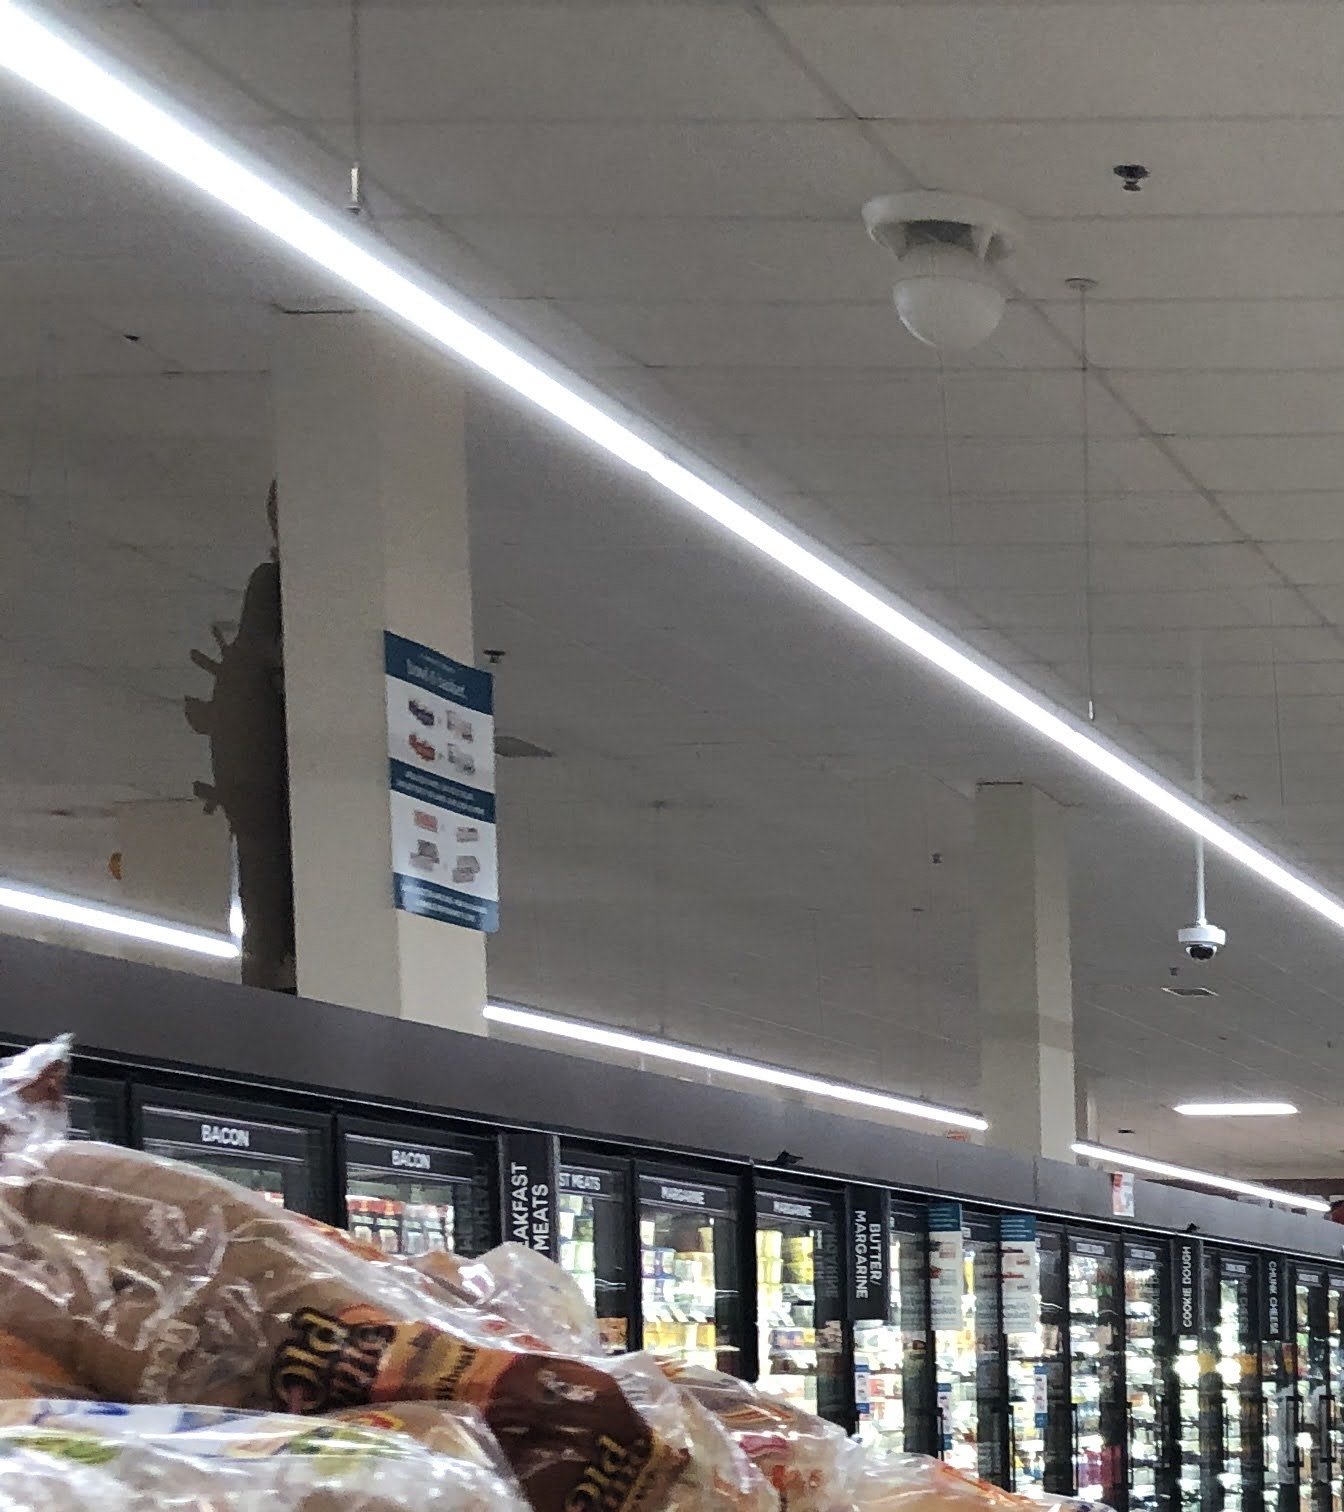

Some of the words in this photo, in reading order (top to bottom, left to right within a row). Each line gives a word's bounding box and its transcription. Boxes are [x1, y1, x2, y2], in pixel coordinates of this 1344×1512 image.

[201, 1124, 250, 1148] BACON
[391, 1149, 431, 1170] BACON
[572, 1171, 601, 1191] MEATS
[511, 1161, 529, 1247] AKFAST
[531, 1184, 549, 1251] MEATS
[855, 1210, 869, 1299] MARGARINE
[868, 1223, 883, 1286] BUTTER/
[1182, 1246, 1192, 1287] DOUGH
[1268, 1260, 1277, 1294] CHUNK
[1182, 1288, 1193, 1328] COOKIE
